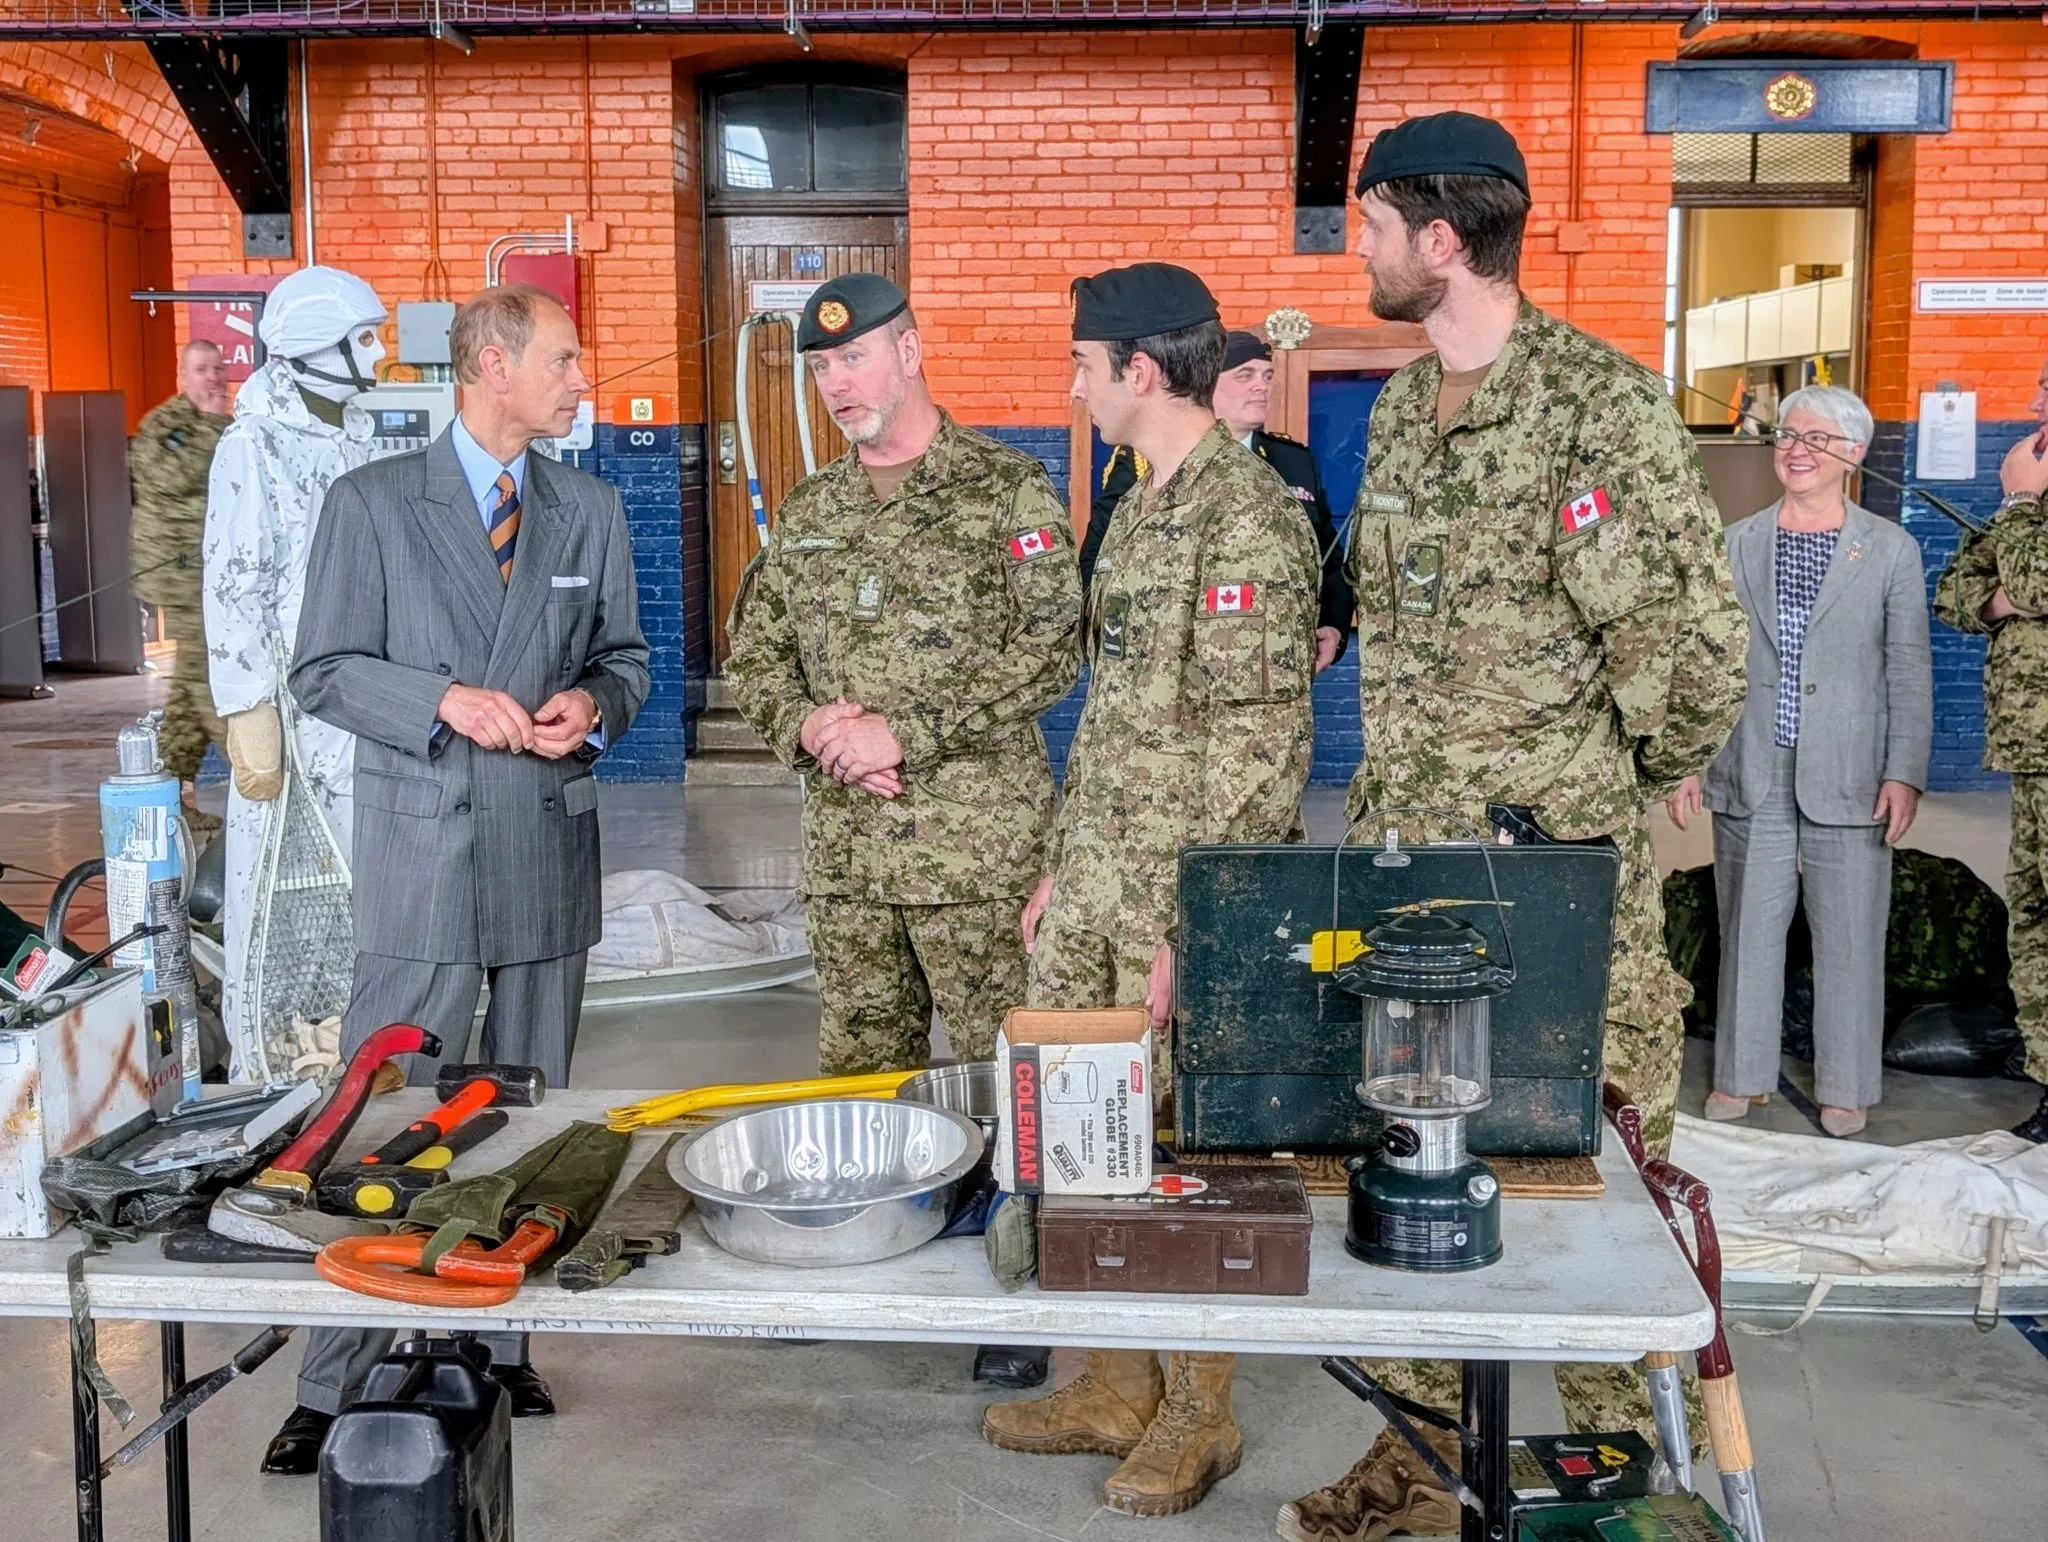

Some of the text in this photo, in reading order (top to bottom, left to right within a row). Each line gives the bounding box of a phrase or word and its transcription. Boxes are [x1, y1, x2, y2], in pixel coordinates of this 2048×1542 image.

[799, 255, 822, 268] 110
[629, 430, 655, 447] CO
[1401, 599, 1433, 610] CANADA
[1014, 1060, 1039, 1180] COLEMAN
[1105, 1097, 1118, 1179] GLOBE #330
[1117, 1079, 1130, 1179] REPLACEMENT
[1133, 1134, 1143, 1178] 690A048C
